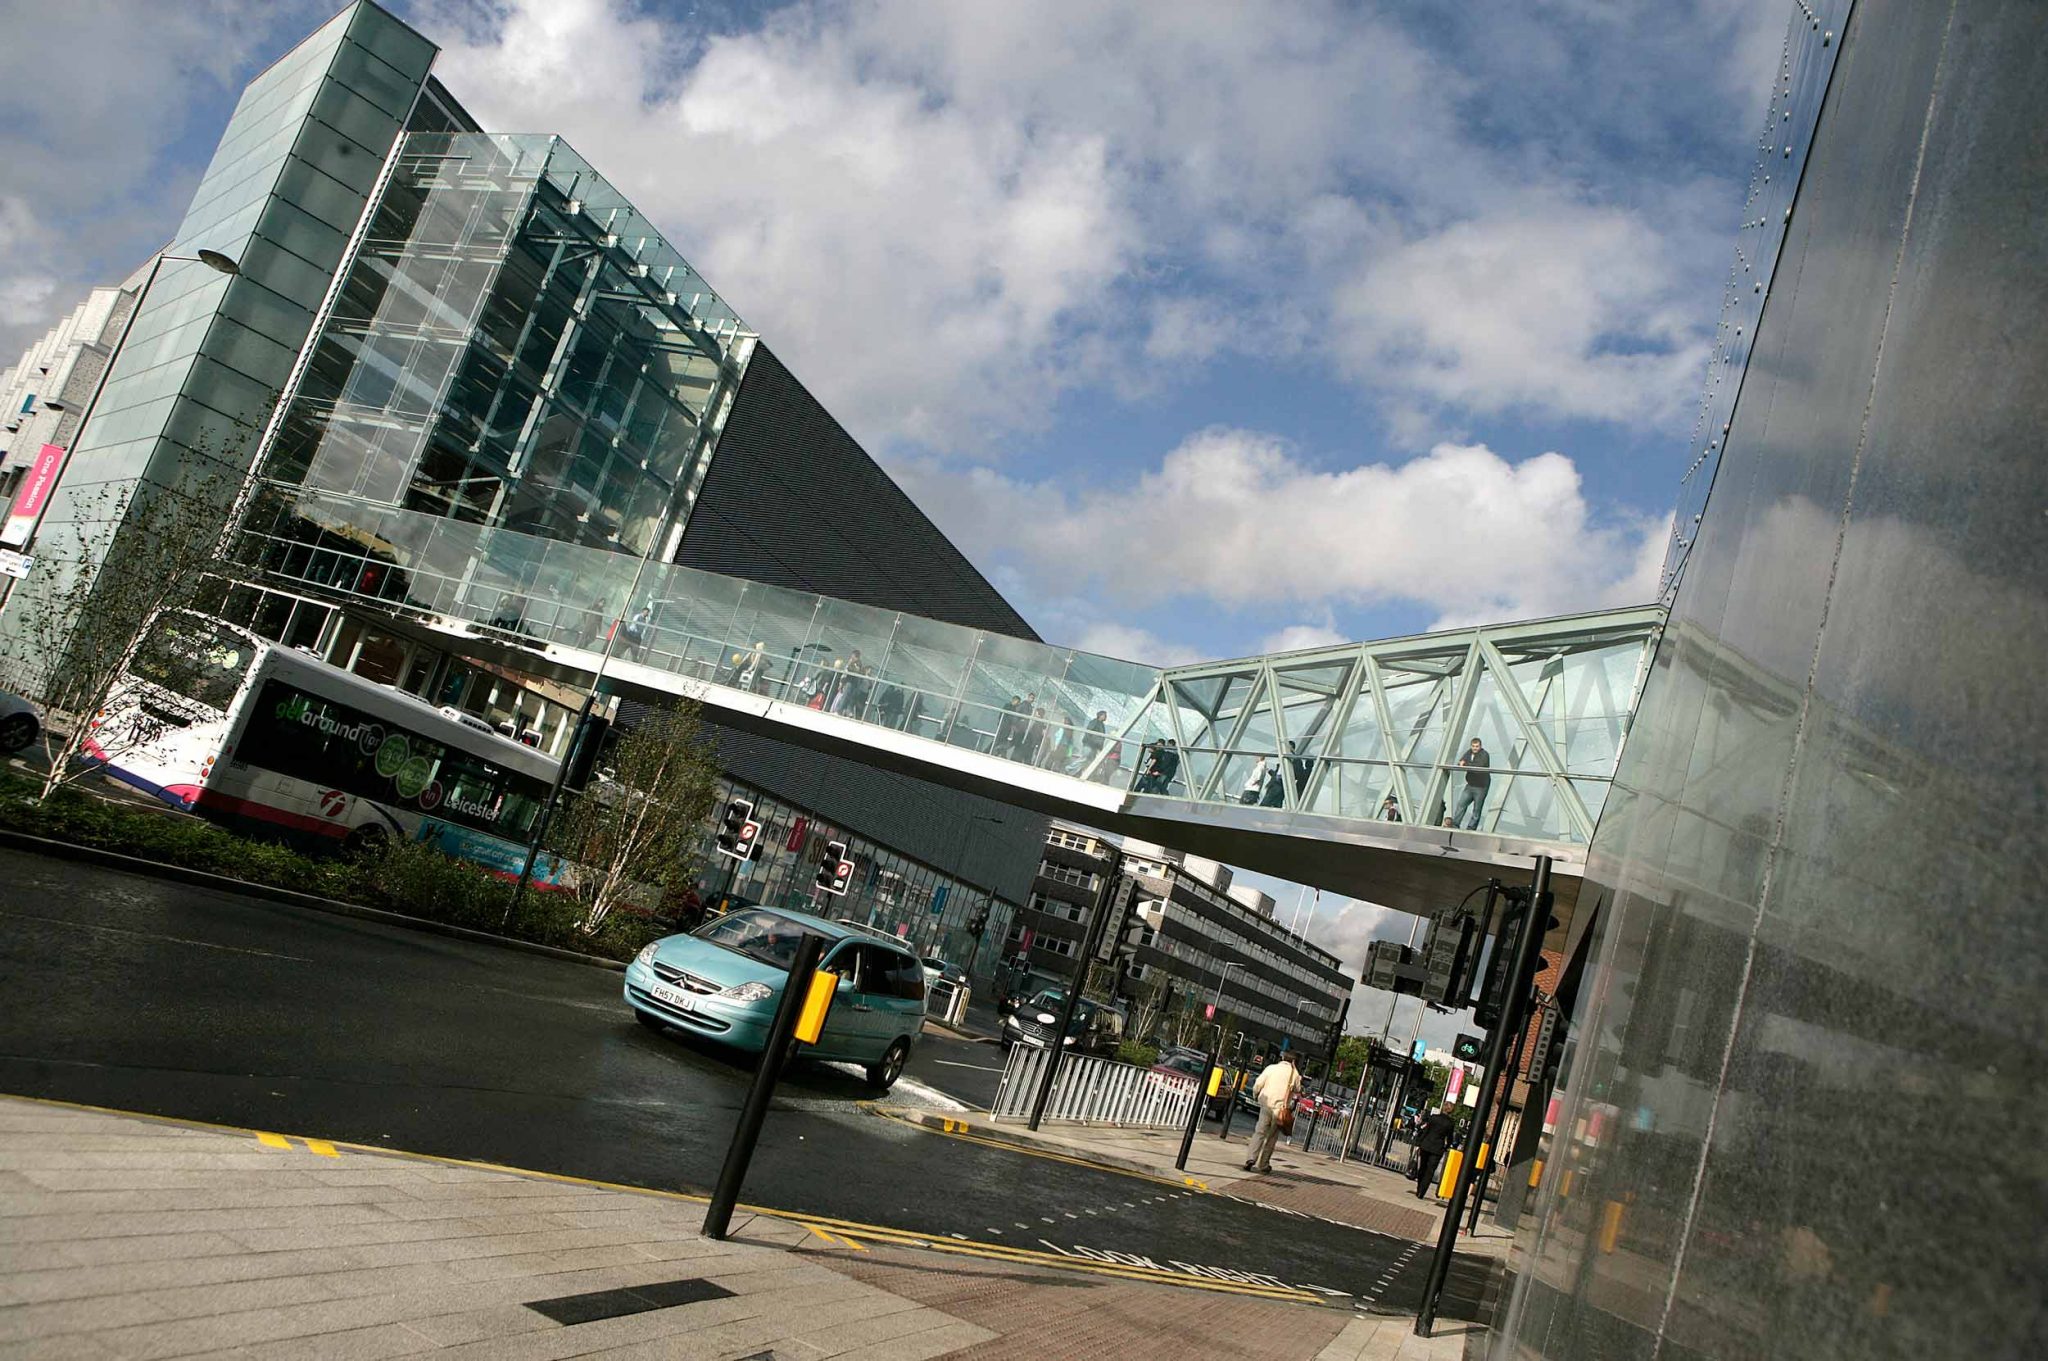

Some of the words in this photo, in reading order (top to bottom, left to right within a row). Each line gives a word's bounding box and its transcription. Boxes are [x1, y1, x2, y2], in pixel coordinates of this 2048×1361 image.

[41, 455, 54, 475] One
[25, 475, 47, 509] Passion
[443, 791, 501, 822] Leicester
[654, 987, 674, 1001] FH57
[674, 995, 691, 1008] DKJ
[1038, 1239, 1173, 1272] LOOK
[1168, 1260, 1295, 1290] RIGHT
